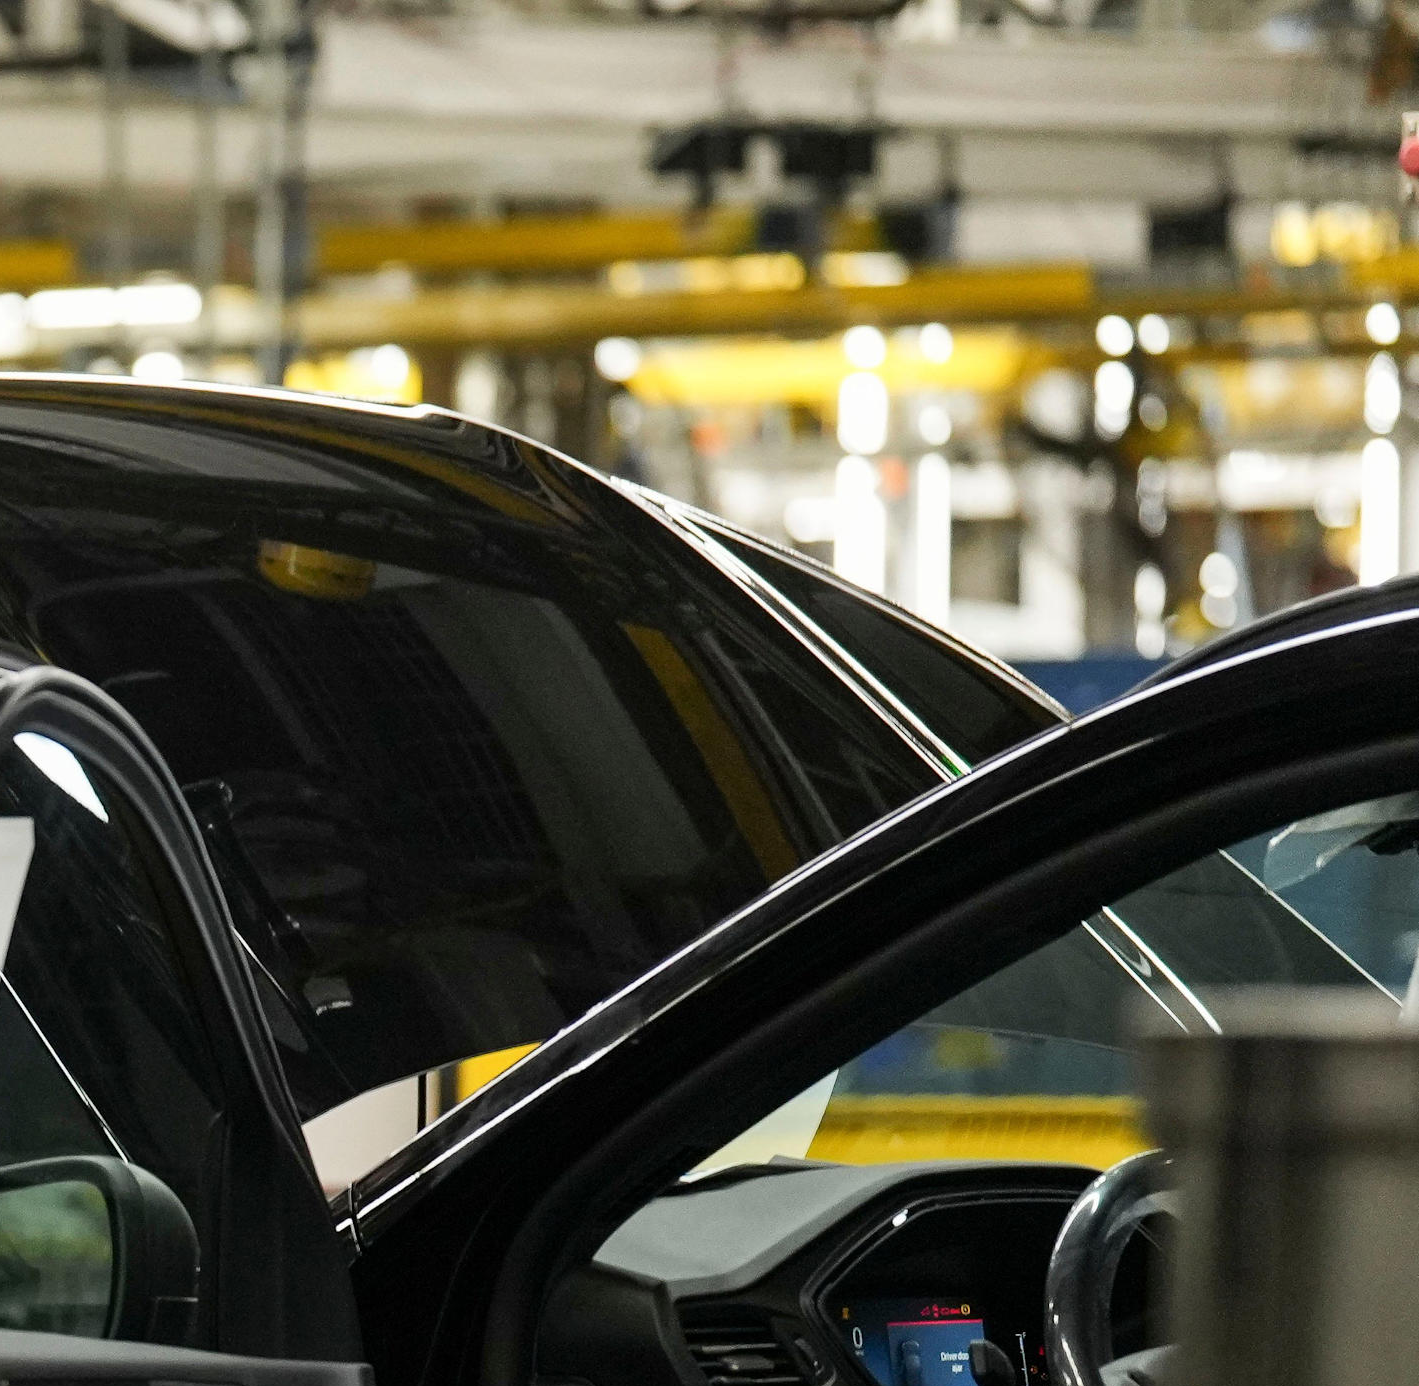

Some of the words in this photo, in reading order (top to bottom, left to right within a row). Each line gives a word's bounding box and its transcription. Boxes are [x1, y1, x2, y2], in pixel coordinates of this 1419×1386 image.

[853, 1326, 863, 1349] 0
[941, 1351, 957, 1361] Driver
[958, 1351, 969, 1361] doo
